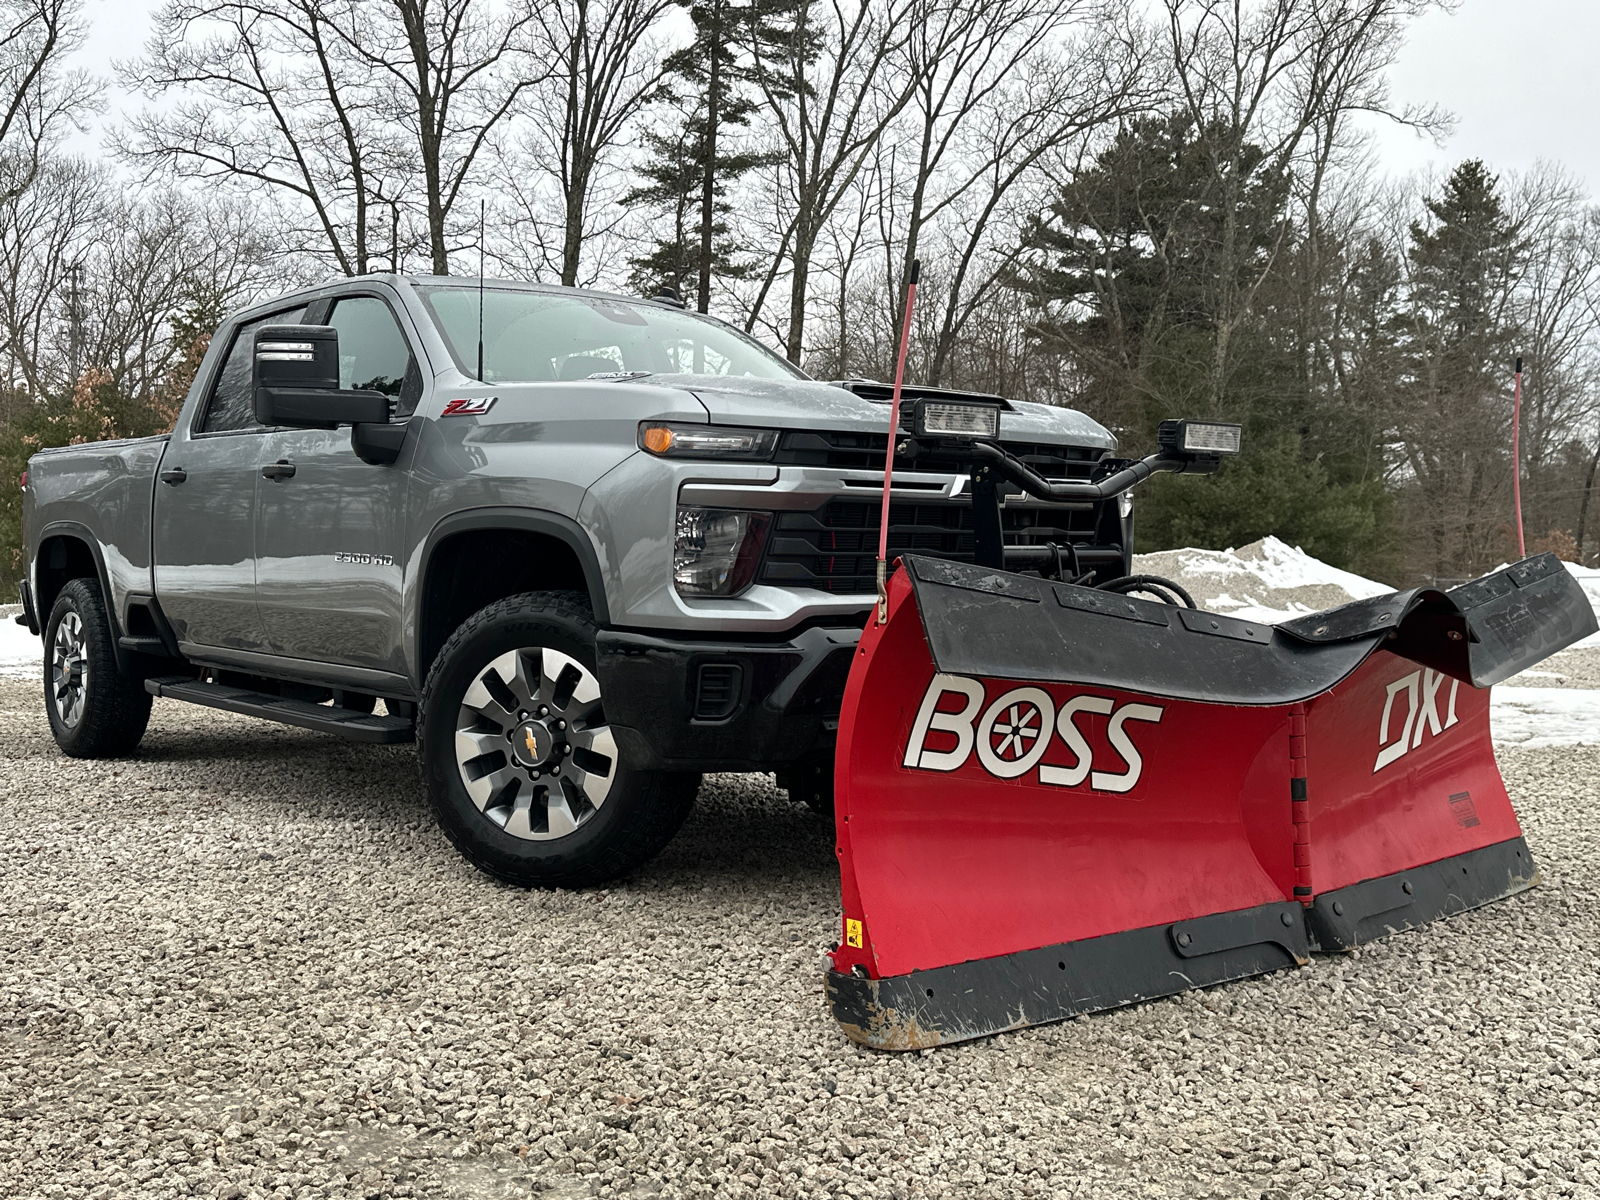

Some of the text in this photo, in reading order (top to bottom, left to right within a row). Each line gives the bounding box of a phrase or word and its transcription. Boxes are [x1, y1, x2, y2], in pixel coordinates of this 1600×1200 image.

[440, 397, 498, 418] Z71
[334, 551, 371, 564] 2500
[902, 673, 1164, 793] BOSS
